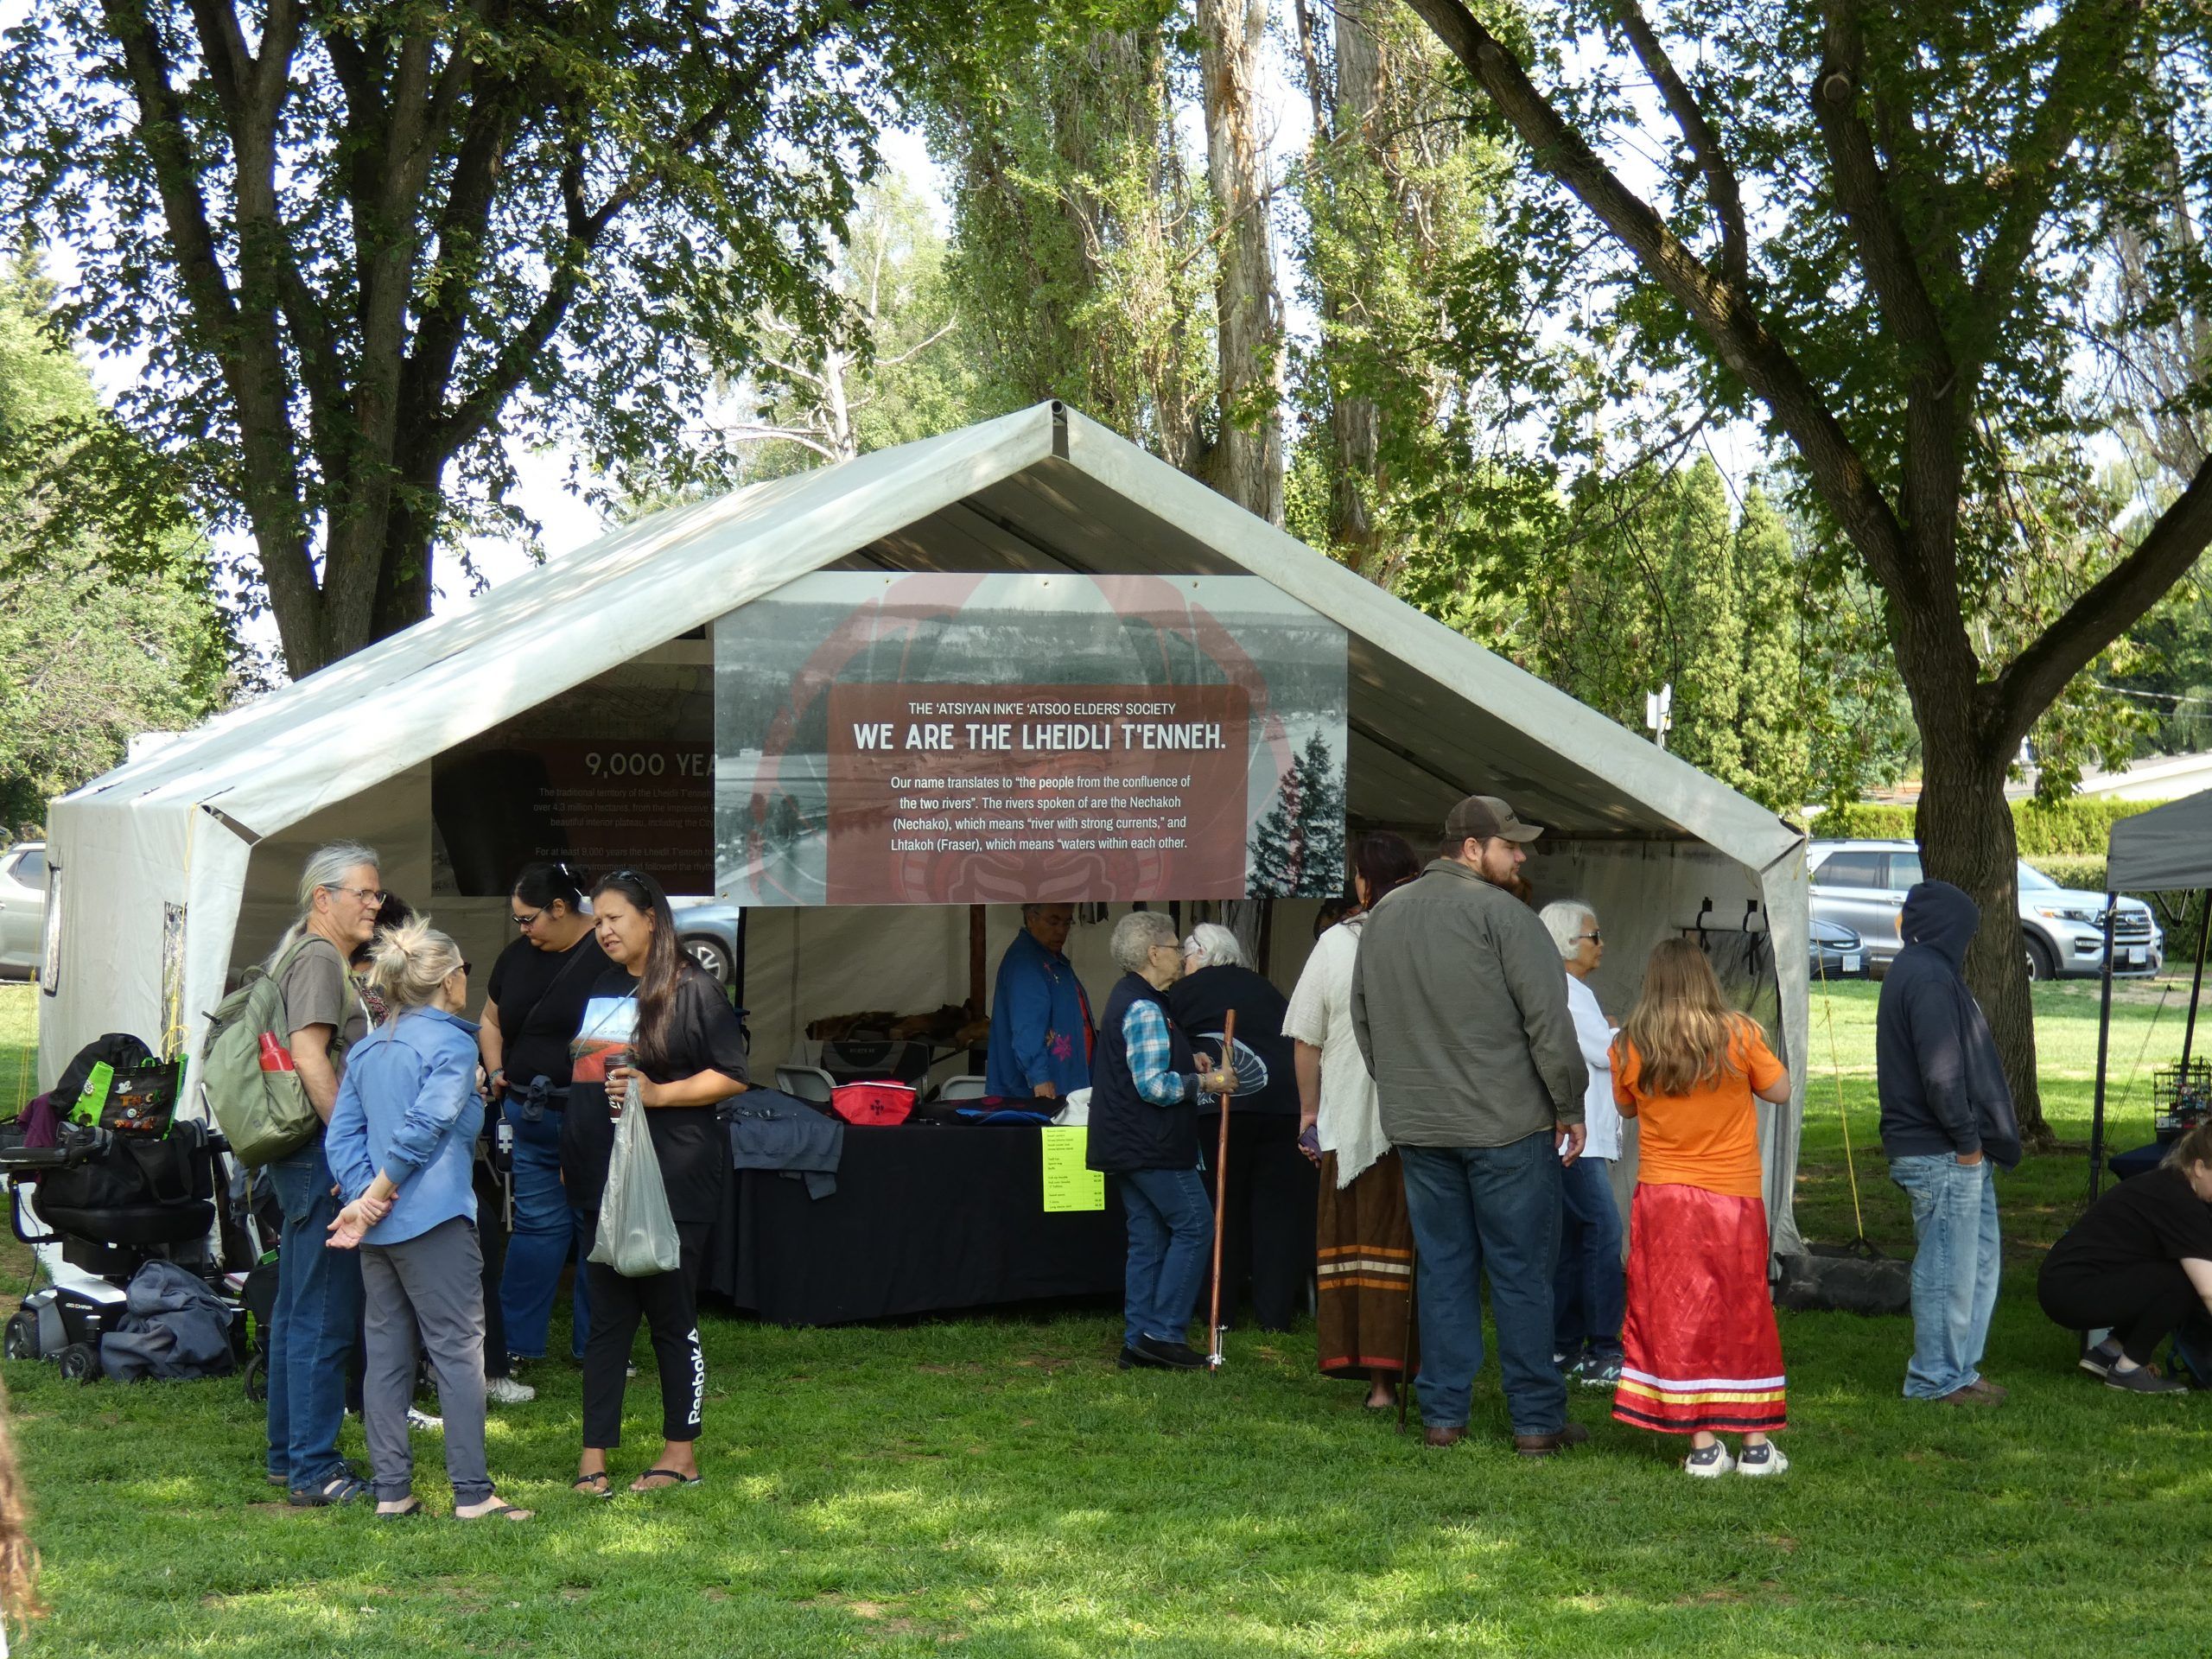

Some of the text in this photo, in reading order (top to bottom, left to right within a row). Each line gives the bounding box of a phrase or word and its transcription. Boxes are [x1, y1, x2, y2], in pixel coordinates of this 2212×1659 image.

[907, 702, 933, 715] THE
[1125, 702, 1177, 715] SOCIETY
[853, 723, 1226, 750] WE ARE THE LHEIDLI T'ENNEH.
[585, 752, 665, 779] 9,000
[890, 776, 912, 789] Our
[914, 778, 945, 789] name
[947, 775, 1000, 789] translates
[1001, 776, 1013, 789] to
[1039, 775, 1075, 791] people
[1077, 775, 1101, 788] from
[1103, 775, 1120, 788] the
[1122, 774, 1179, 788] confluence
[1180, 774, 1192, 788] of
[899, 796, 918, 810] the
[919, 797, 939, 810] two
[981, 796, 1003, 810] The
[1005, 796, 1034, 810] rivers
[1036, 796, 1075, 811] spoken
[1077, 796, 1089, 809] of
[1090, 797, 1108, 809] are
[1109, 795, 1128, 809] the
[1129, 795, 1181, 809] Nechakoh
[893, 817, 952, 833] (Nechako),
[954, 817, 986, 830] which
[987, 818, 1025, 830] means
[1056, 817, 1078, 830] with
[1080, 817, 1114, 831] strong
[1166, 815, 1187, 829] and
[891, 837, 934, 851] Lhtakoh
[937, 837, 982, 853] (Fraser),
[985, 837, 1016, 850] which
[1019, 840, 1055, 850] means
[1097, 836, 1128, 849] within
[1130, 836, 1156, 849] each
[1158, 836, 1188, 849] other.
[688, 1344, 705, 1425] Reebok
